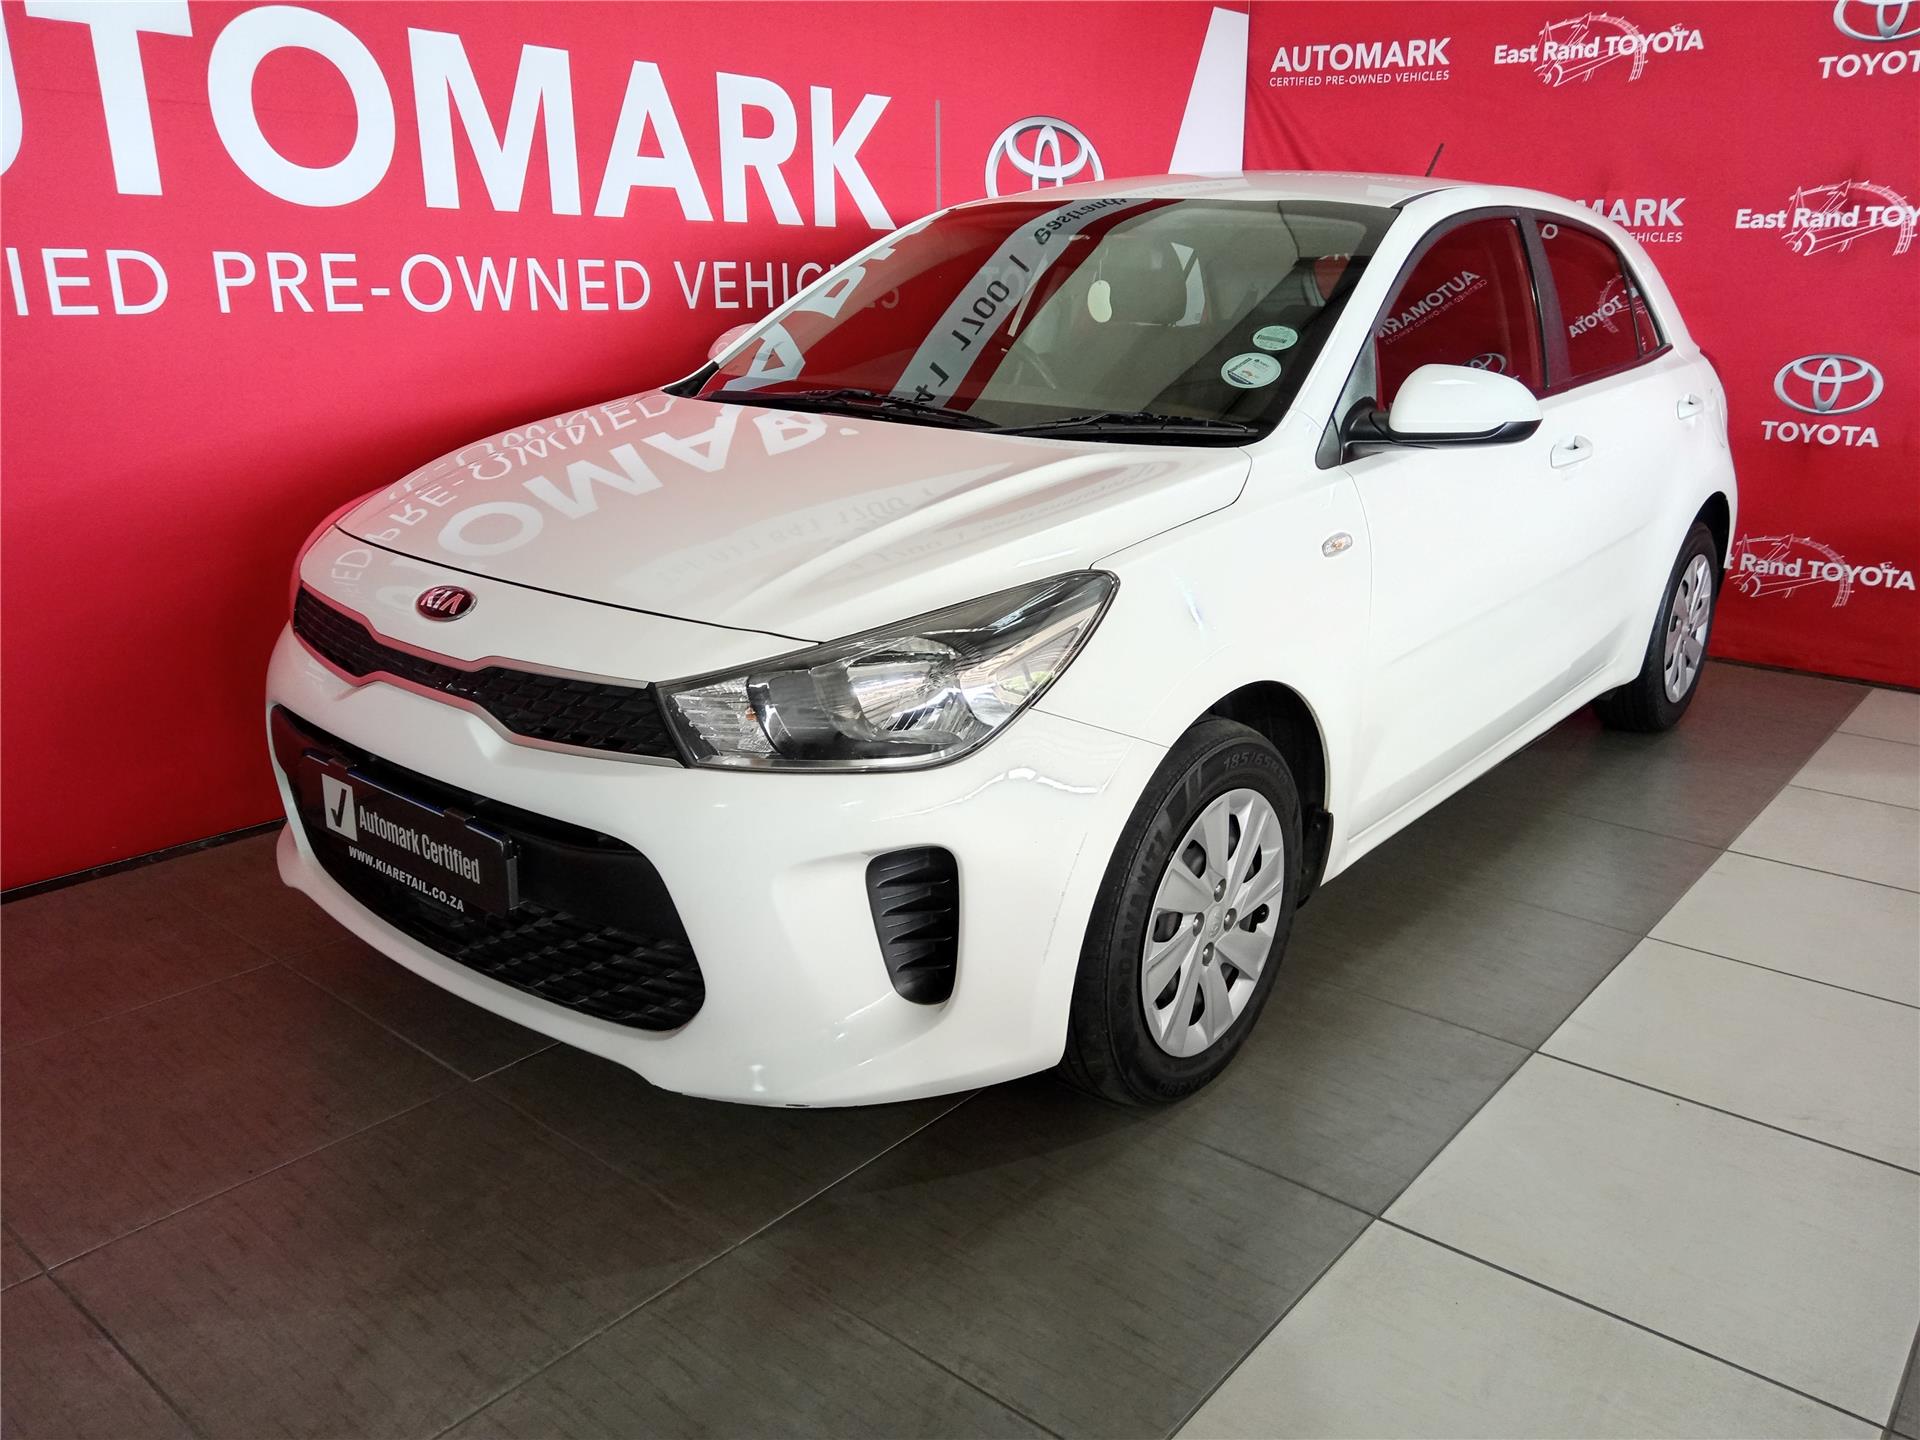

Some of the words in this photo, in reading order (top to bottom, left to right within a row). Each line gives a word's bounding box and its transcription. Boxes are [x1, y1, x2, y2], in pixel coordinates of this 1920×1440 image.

[1270, 37, 1451, 73] AUTOMARK
[1494, 44, 1538, 64] East
[1543, 36, 1600, 60] Rand
[1605, 29, 1704, 57] TOYOTA
[1269, 76, 1322, 87] CERTIFIED
[1325, 73, 1392, 85] PRE-OWNED
[1395, 69, 1450, 83] VEHICLES
[1735, 208, 1787, 228] East
[1792, 205, 1860, 228] Rand
[212, 251, 652, 315] PRE-OWNED
[1761, 420, 1880, 449] TOYOTA
[1740, 553, 1801, 578] Rand
[1807, 560, 1916, 591] TOYOTA
[420, 588, 465, 615] KIA
[359, 805, 420, 856] Automark
[421, 834, 481, 885] Certified
